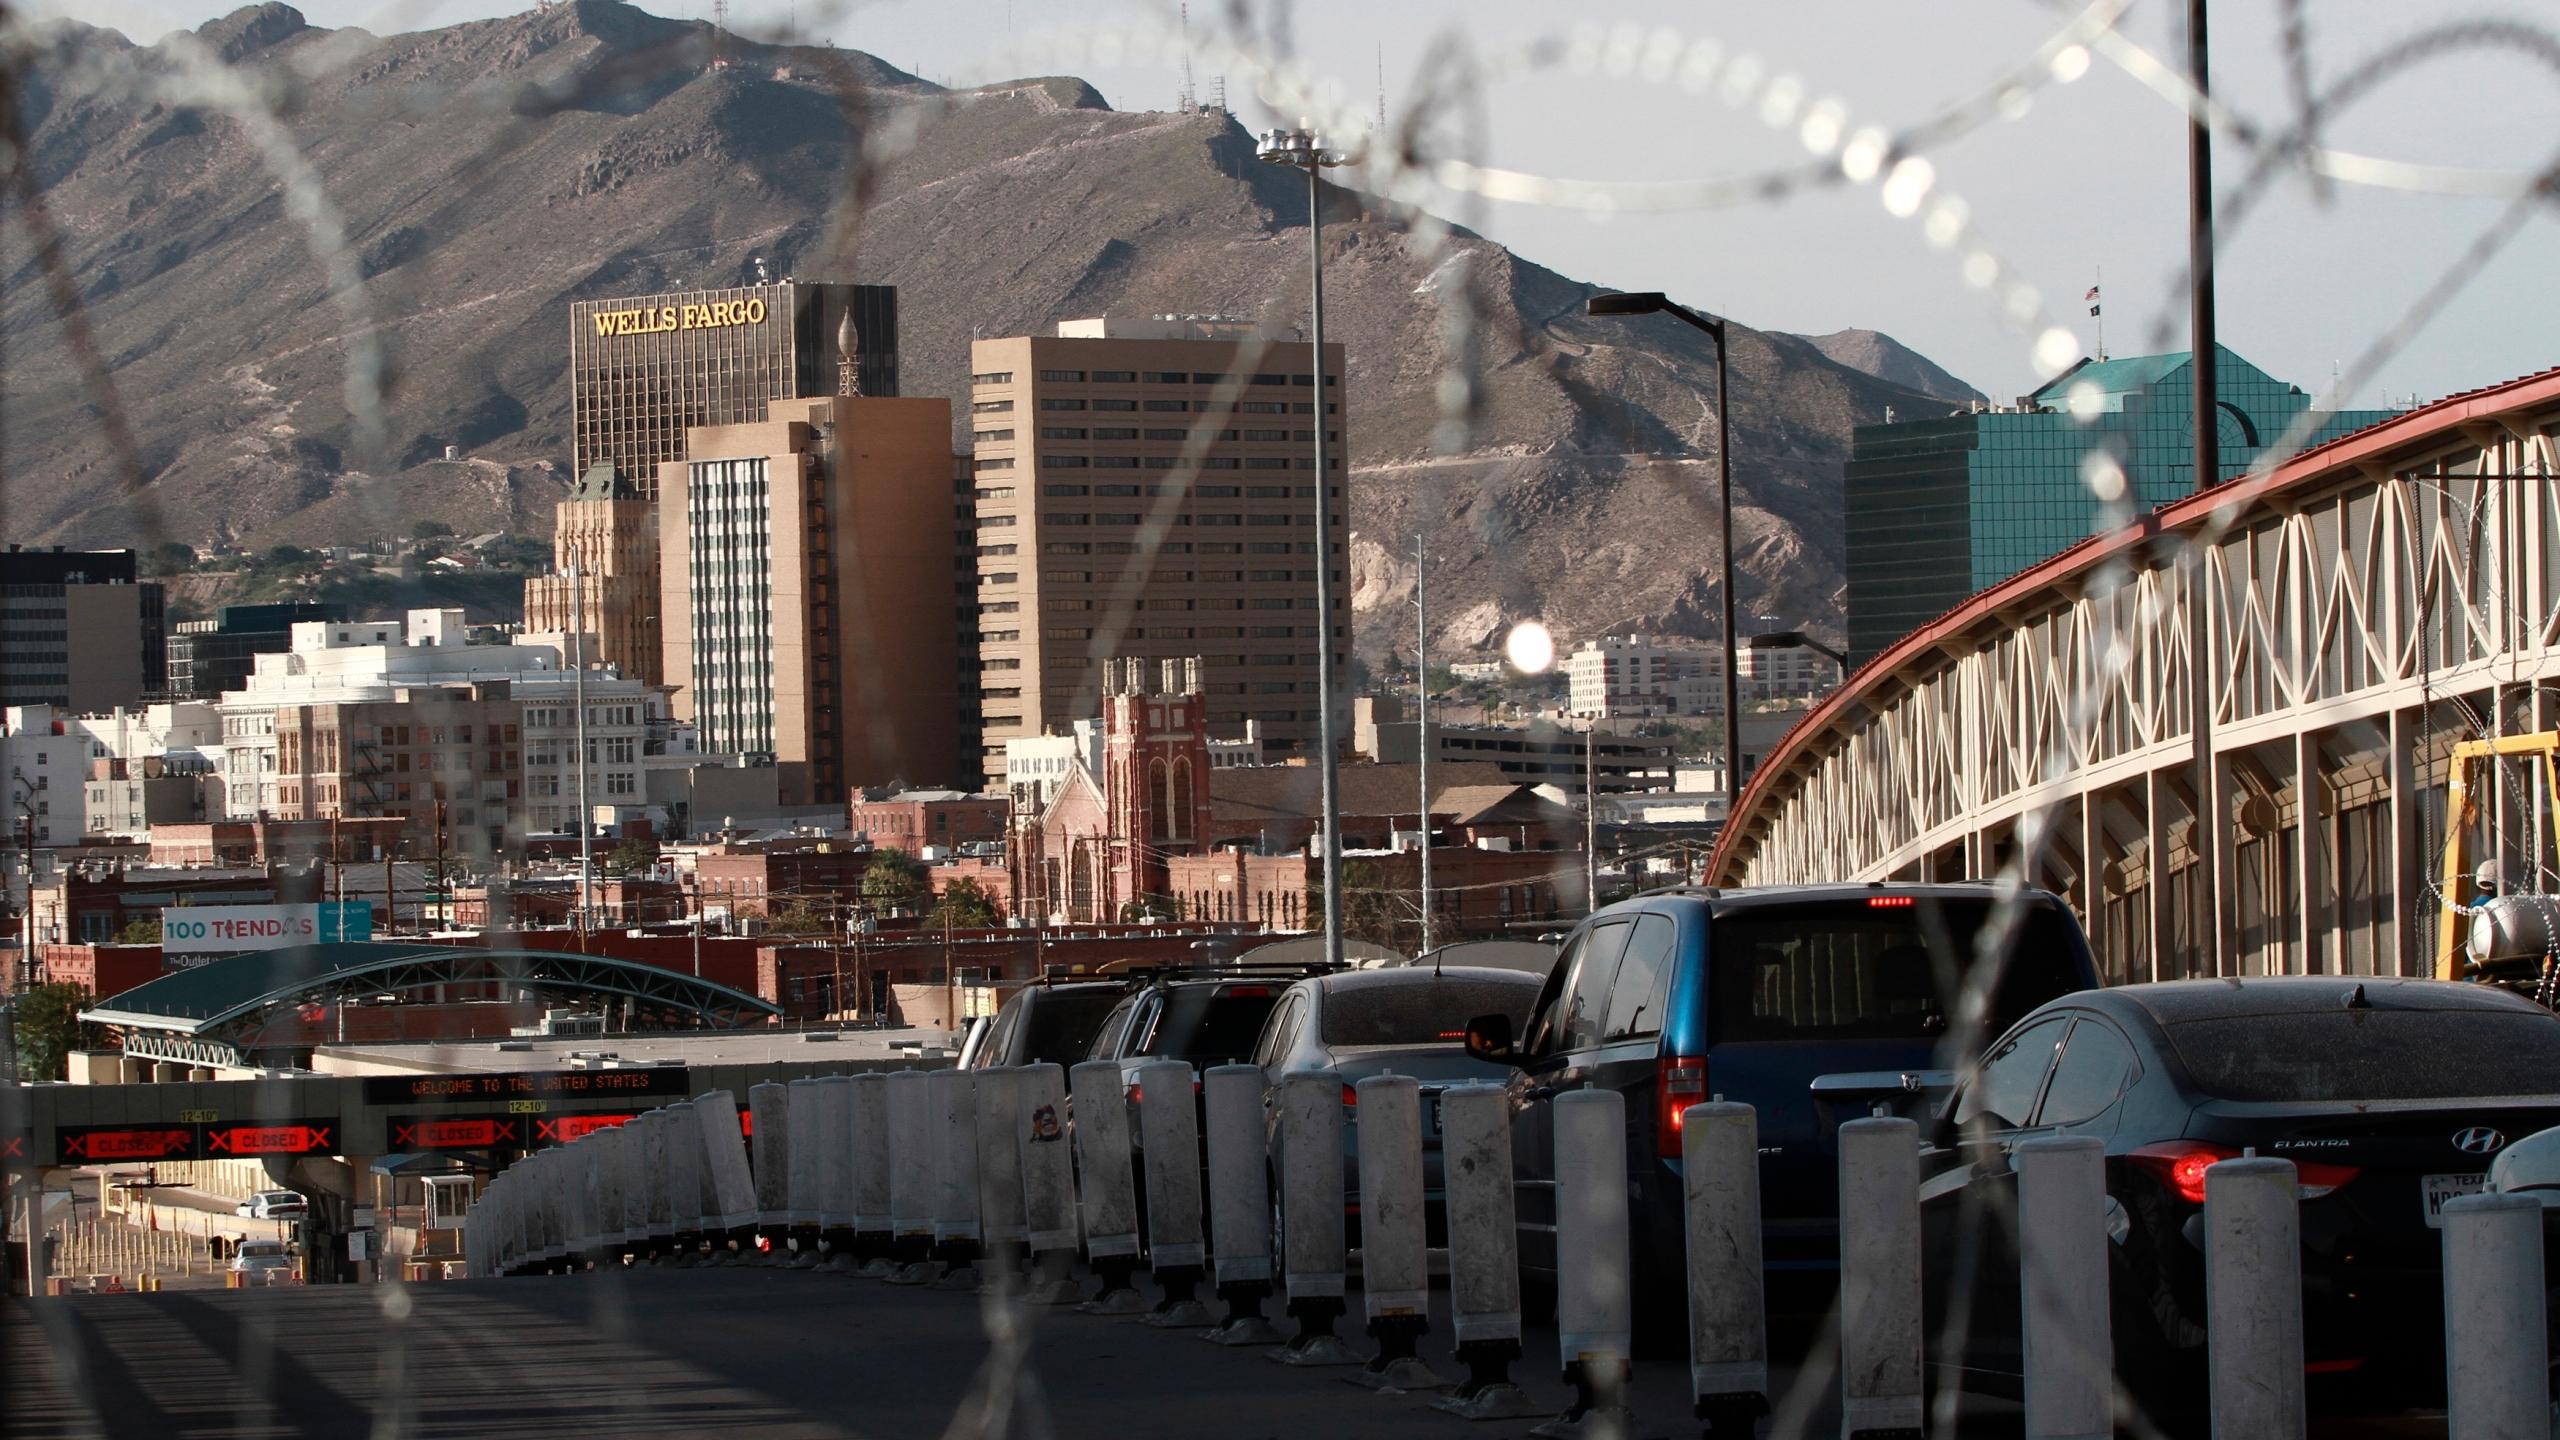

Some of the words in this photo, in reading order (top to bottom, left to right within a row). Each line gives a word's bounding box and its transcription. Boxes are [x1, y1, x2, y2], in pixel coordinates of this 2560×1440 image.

[593, 306, 678, 336] WELLS
[681, 298, 766, 329] FARGO
[167, 921, 206, 939] 100
[212, 918, 313, 940] TIENDAS
[169, 957, 181, 965] The
[180, 954, 210, 967] Outlet
[411, 1079, 473, 1095] WELCOME
[481, 1079, 499, 1093] TO
[507, 1077, 534, 1092] THE
[541, 1076, 588, 1091] UNITED
[596, 1074, 649, 1089] STATES
[242, 1133, 298, 1147] CLOSED
[427, 1126, 484, 1141] CLOSED
[2274, 1138, 2350, 1149] ELANTRA
[2453, 1174, 2486, 1186] TEXA
